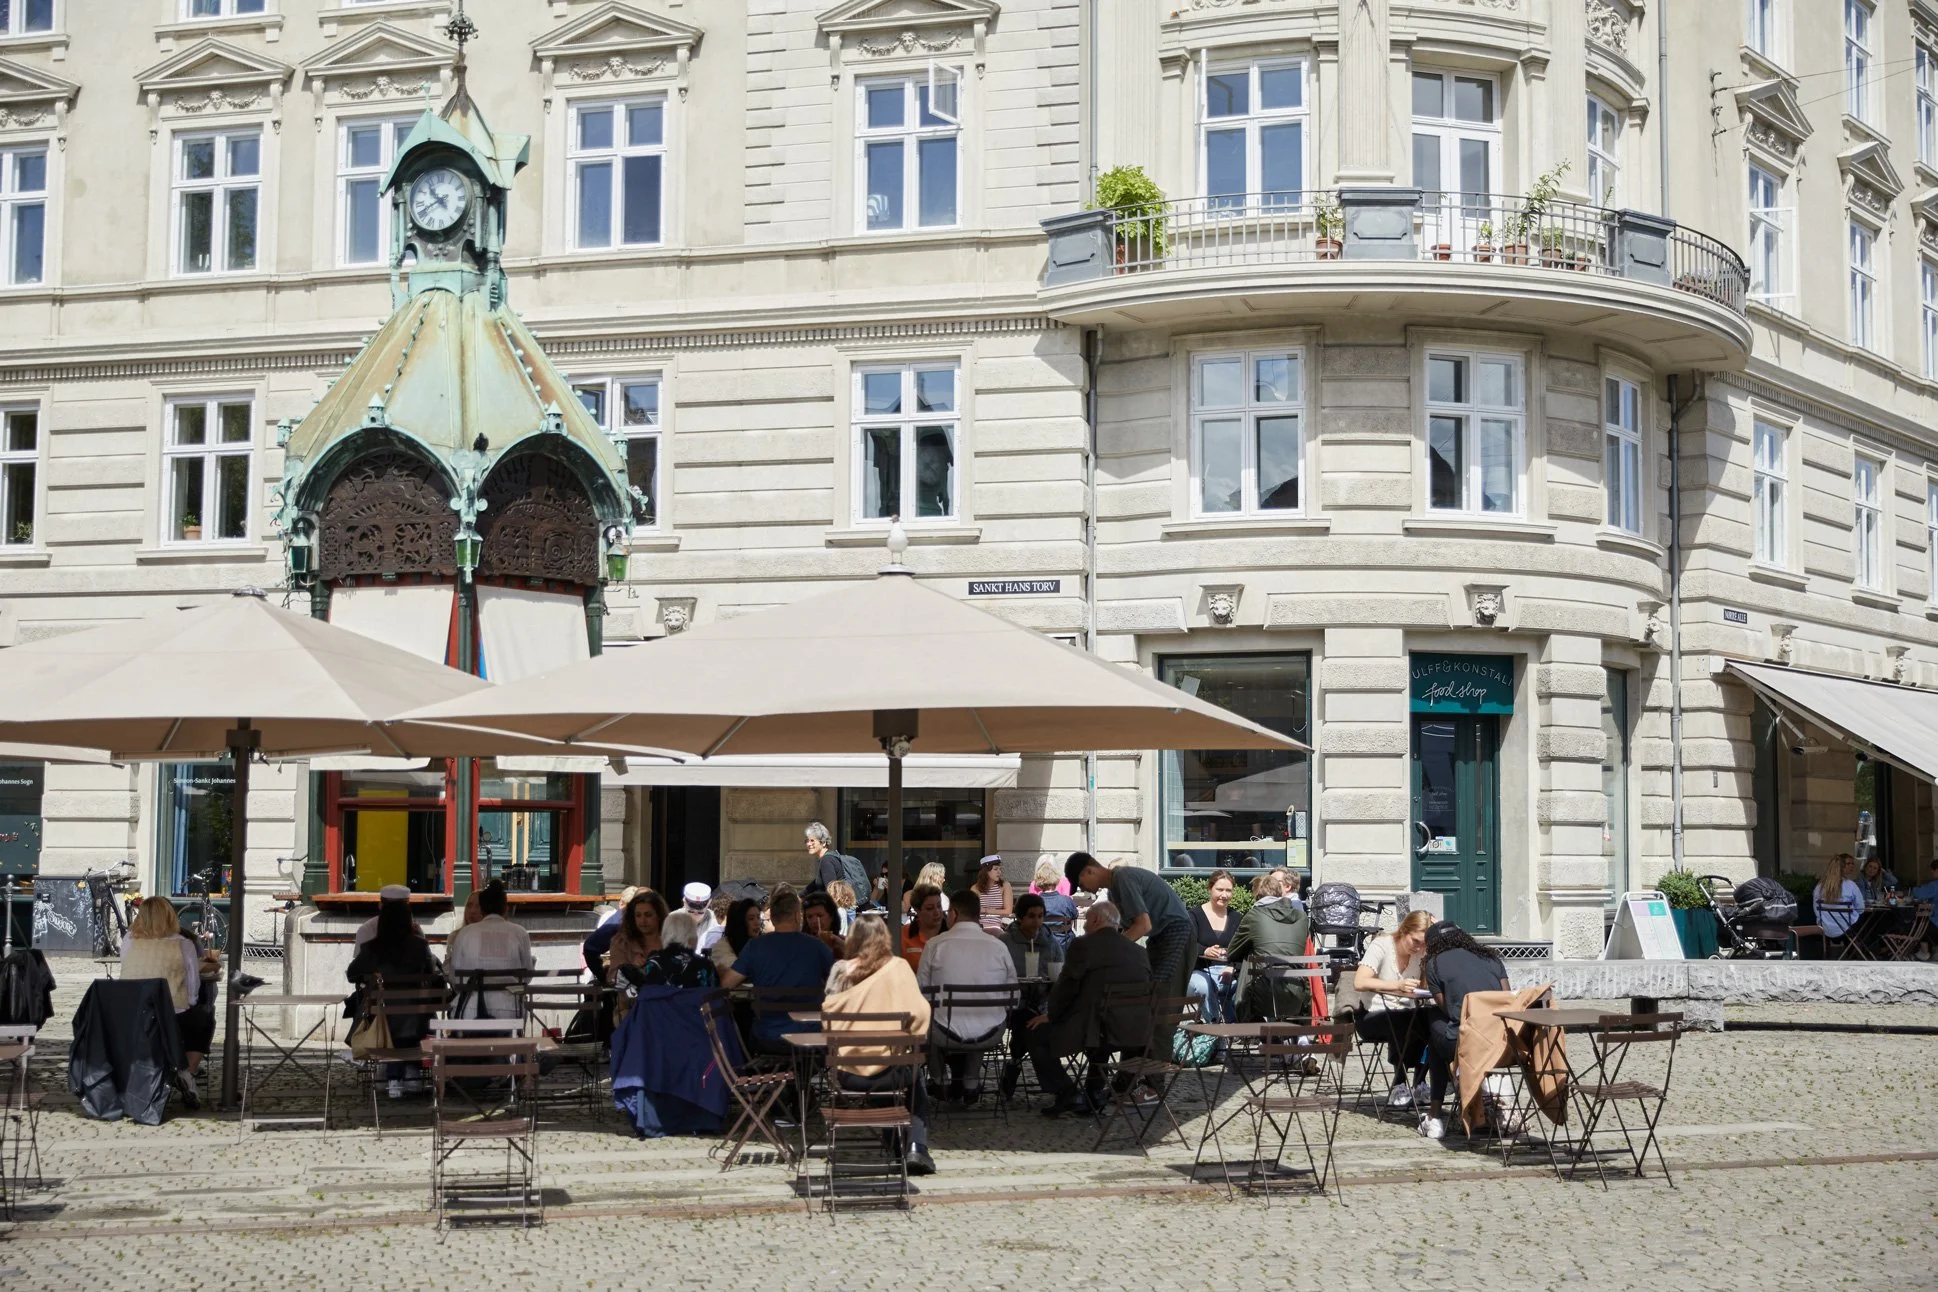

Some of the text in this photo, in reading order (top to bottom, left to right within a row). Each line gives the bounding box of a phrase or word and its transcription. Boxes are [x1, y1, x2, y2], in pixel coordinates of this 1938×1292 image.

[973, 582, 1055, 593] SANKT HANS TORV
[1411, 660, 1513, 687] ULFF&KONSTALI
[1422, 680, 1487, 706] food shop
[211, 777, 236, 785] Johannes
